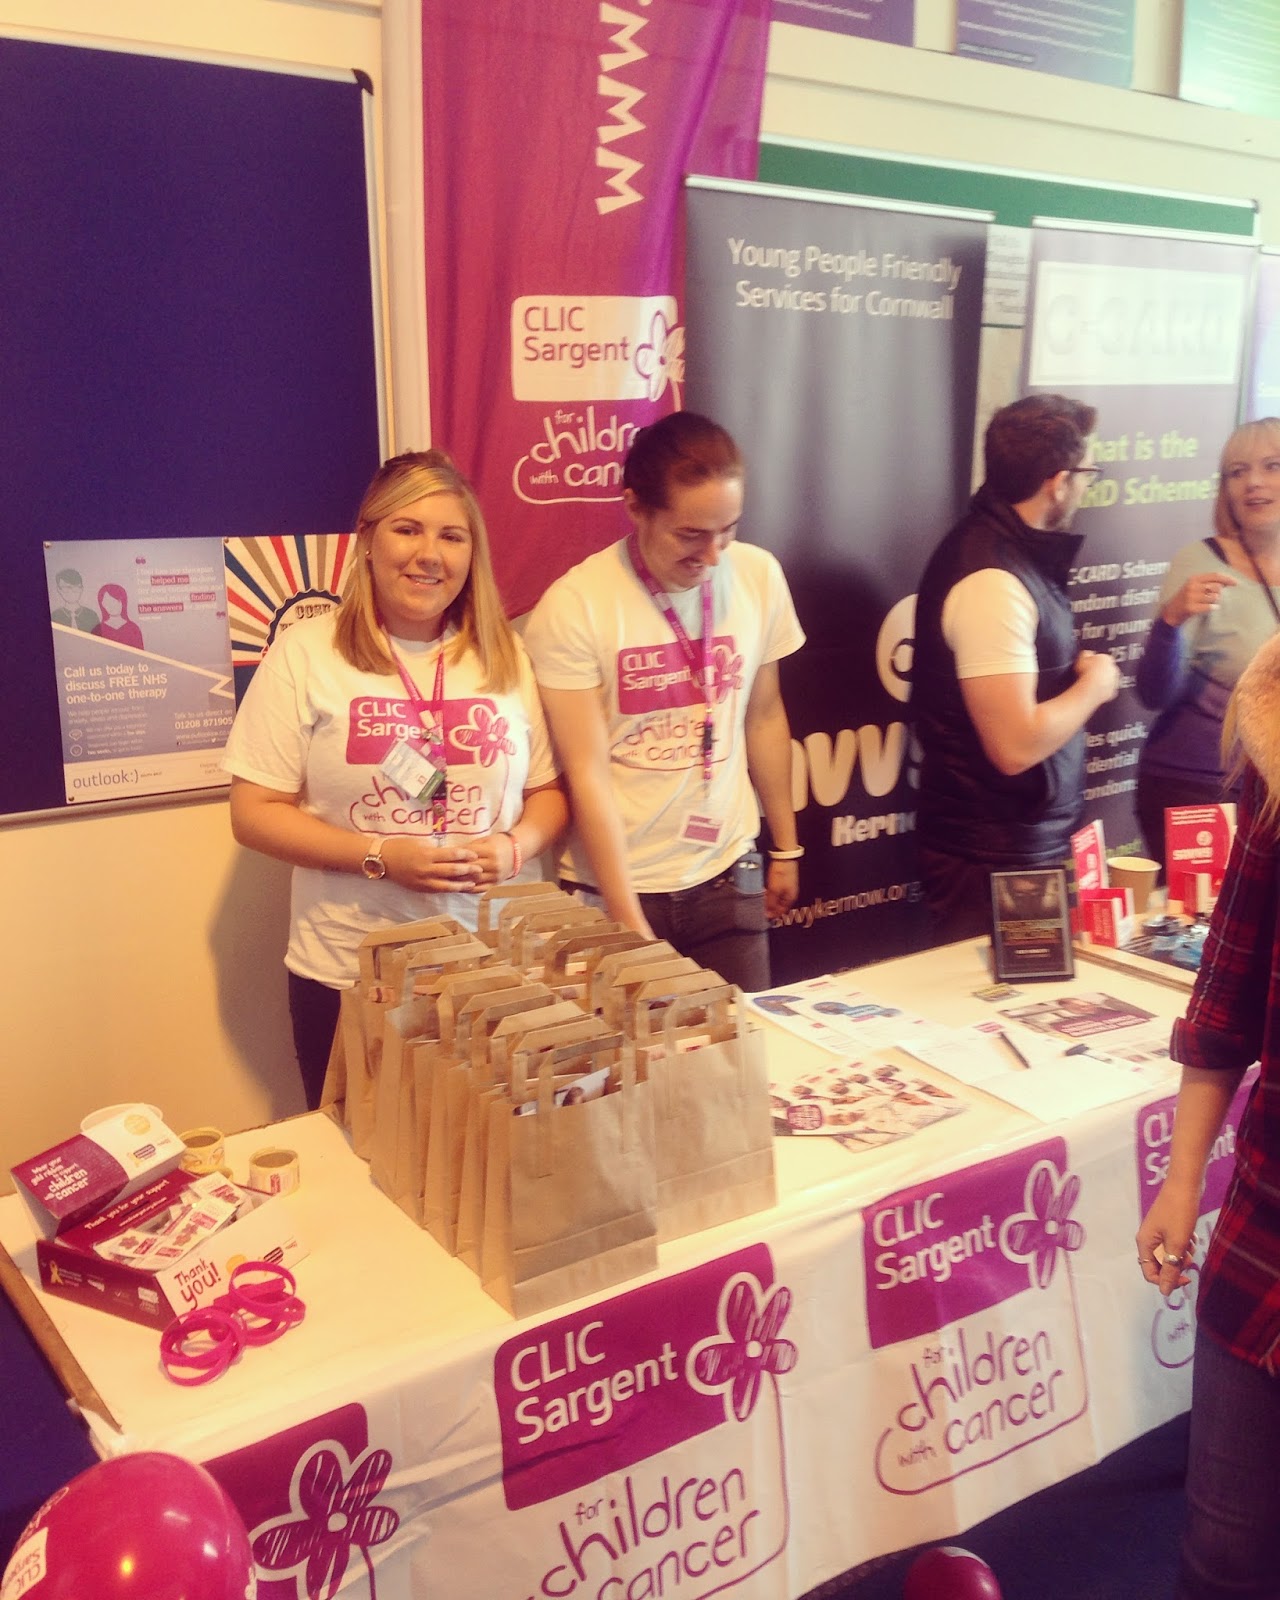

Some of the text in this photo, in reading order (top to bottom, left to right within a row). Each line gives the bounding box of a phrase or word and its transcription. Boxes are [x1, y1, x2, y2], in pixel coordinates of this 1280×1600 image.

[727, 238, 963, 290] Young People Friendly
[736, 280, 954, 320] Services for Cornwall
[524, 306, 584, 332] CLIC
[524, 336, 630, 369] Sargent
[554, 409, 575, 425] for
[530, 405, 641, 464] childr
[1088, 430, 1198, 463] hat is the
[529, 461, 626, 487] with can
[1067, 560, 1171, 585] -CARD Schem
[63, 662, 149, 679] Call us today to
[621, 651, 666, 672] CLIC
[65, 673, 168, 693] discuss FREE NHS
[622, 665, 692, 692] Sargent
[66, 688, 168, 705] one-to-one therapy
[357, 701, 407, 719] CLIC
[174, 716, 234, 730] 01208 871905
[356, 719, 424, 742] Sarge
[361, 776, 482, 808] chen
[832, 813, 917, 847] Kern
[770, 881, 922, 929] vvykernow.org
[1143, 1111, 1176, 1149] CL
[48, 1168, 89, 1193] children
[55, 1177, 89, 1201] cancer
[872, 1192, 945, 1249] CLIC
[873, 1214, 998, 1291] Sargent
[173, 1258, 209, 1287] Thank
[180, 1262, 222, 1311] you!
[509, 1320, 606, 1393] CLIC
[514, 1341, 680, 1446] Sargent
[897, 1327, 1053, 1432] children
[943, 1369, 1064, 1455] cancer
[575, 1498, 605, 1525] for
[540, 1467, 746, 1598] children
[597, 1509, 761, 1600] cancer
